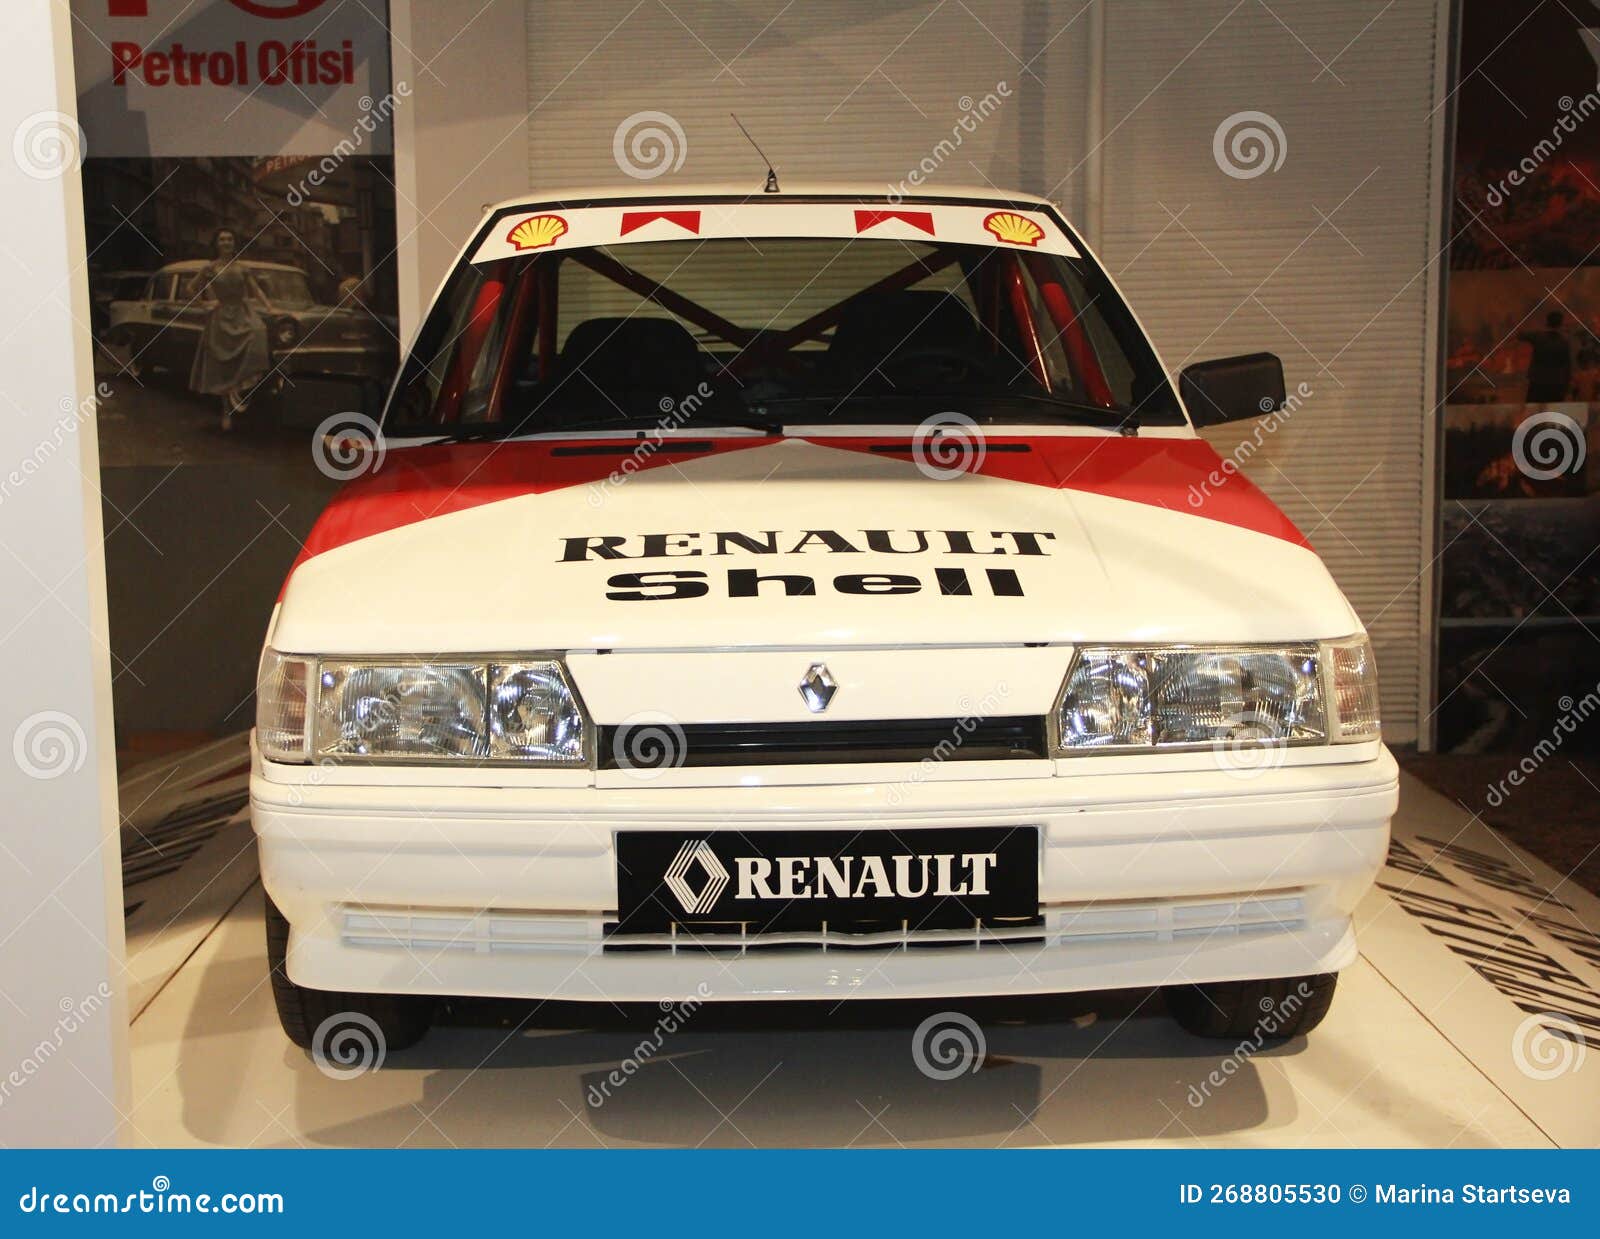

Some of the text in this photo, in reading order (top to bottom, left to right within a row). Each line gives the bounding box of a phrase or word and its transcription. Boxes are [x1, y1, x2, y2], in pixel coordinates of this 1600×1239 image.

[111, 39, 354, 87] Petrol Ofisi
[555, 529, 1057, 563] RENAULT
[605, 567, 1025, 601] Shell
[734, 853, 997, 900] RENAULT
